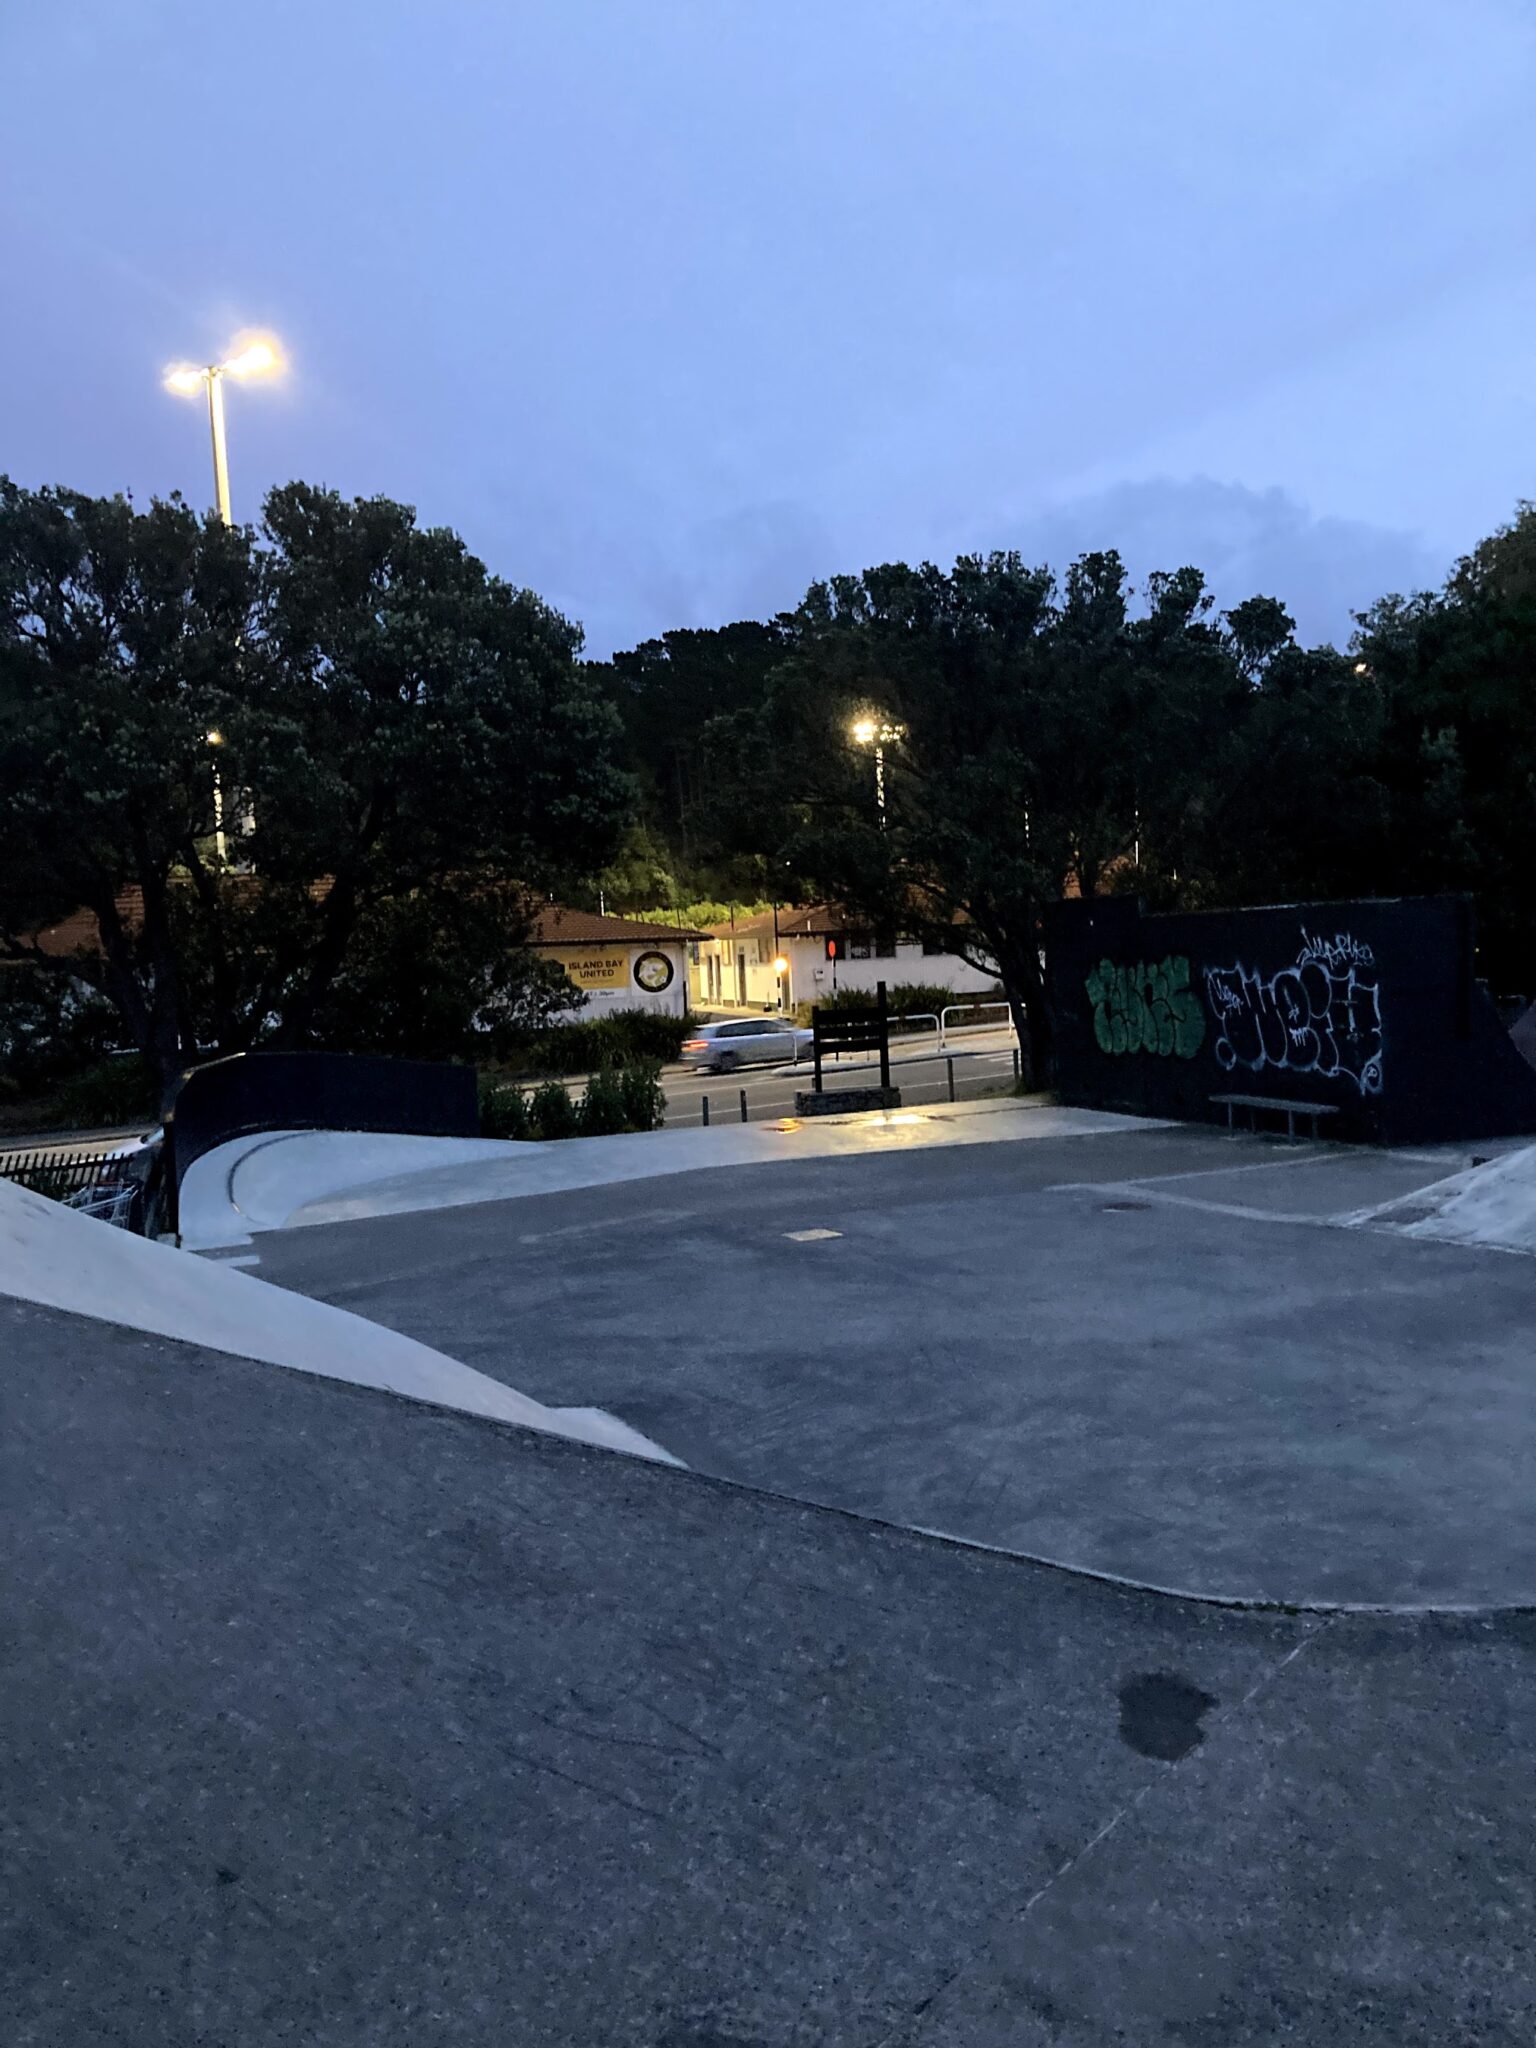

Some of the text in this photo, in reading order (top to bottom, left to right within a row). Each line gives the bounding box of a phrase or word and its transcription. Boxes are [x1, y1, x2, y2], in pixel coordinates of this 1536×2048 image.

[568, 960, 623, 970] ISLAND BAY
[579, 969, 615, 978] UNITED
